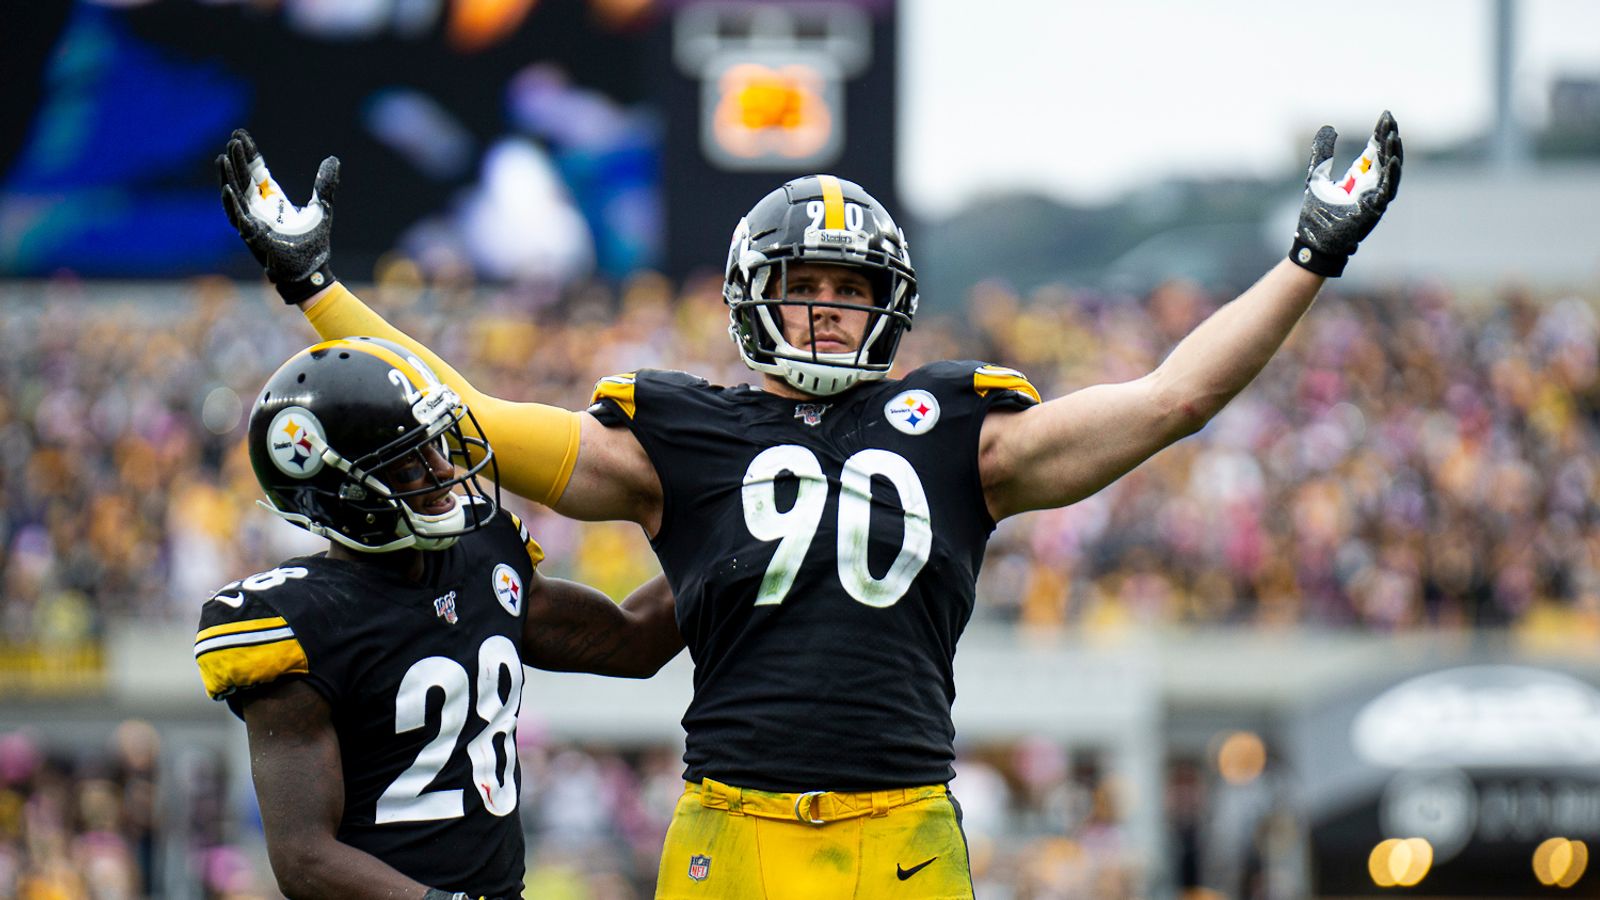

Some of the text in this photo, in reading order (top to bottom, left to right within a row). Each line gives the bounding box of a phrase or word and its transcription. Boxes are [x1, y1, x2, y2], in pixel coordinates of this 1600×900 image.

[806, 200, 863, 232] 90
[820, 231, 853, 244] Steelers
[741, 444, 933, 608] 90
[375, 635, 523, 825] 28
[691, 865, 705, 877] NFL
